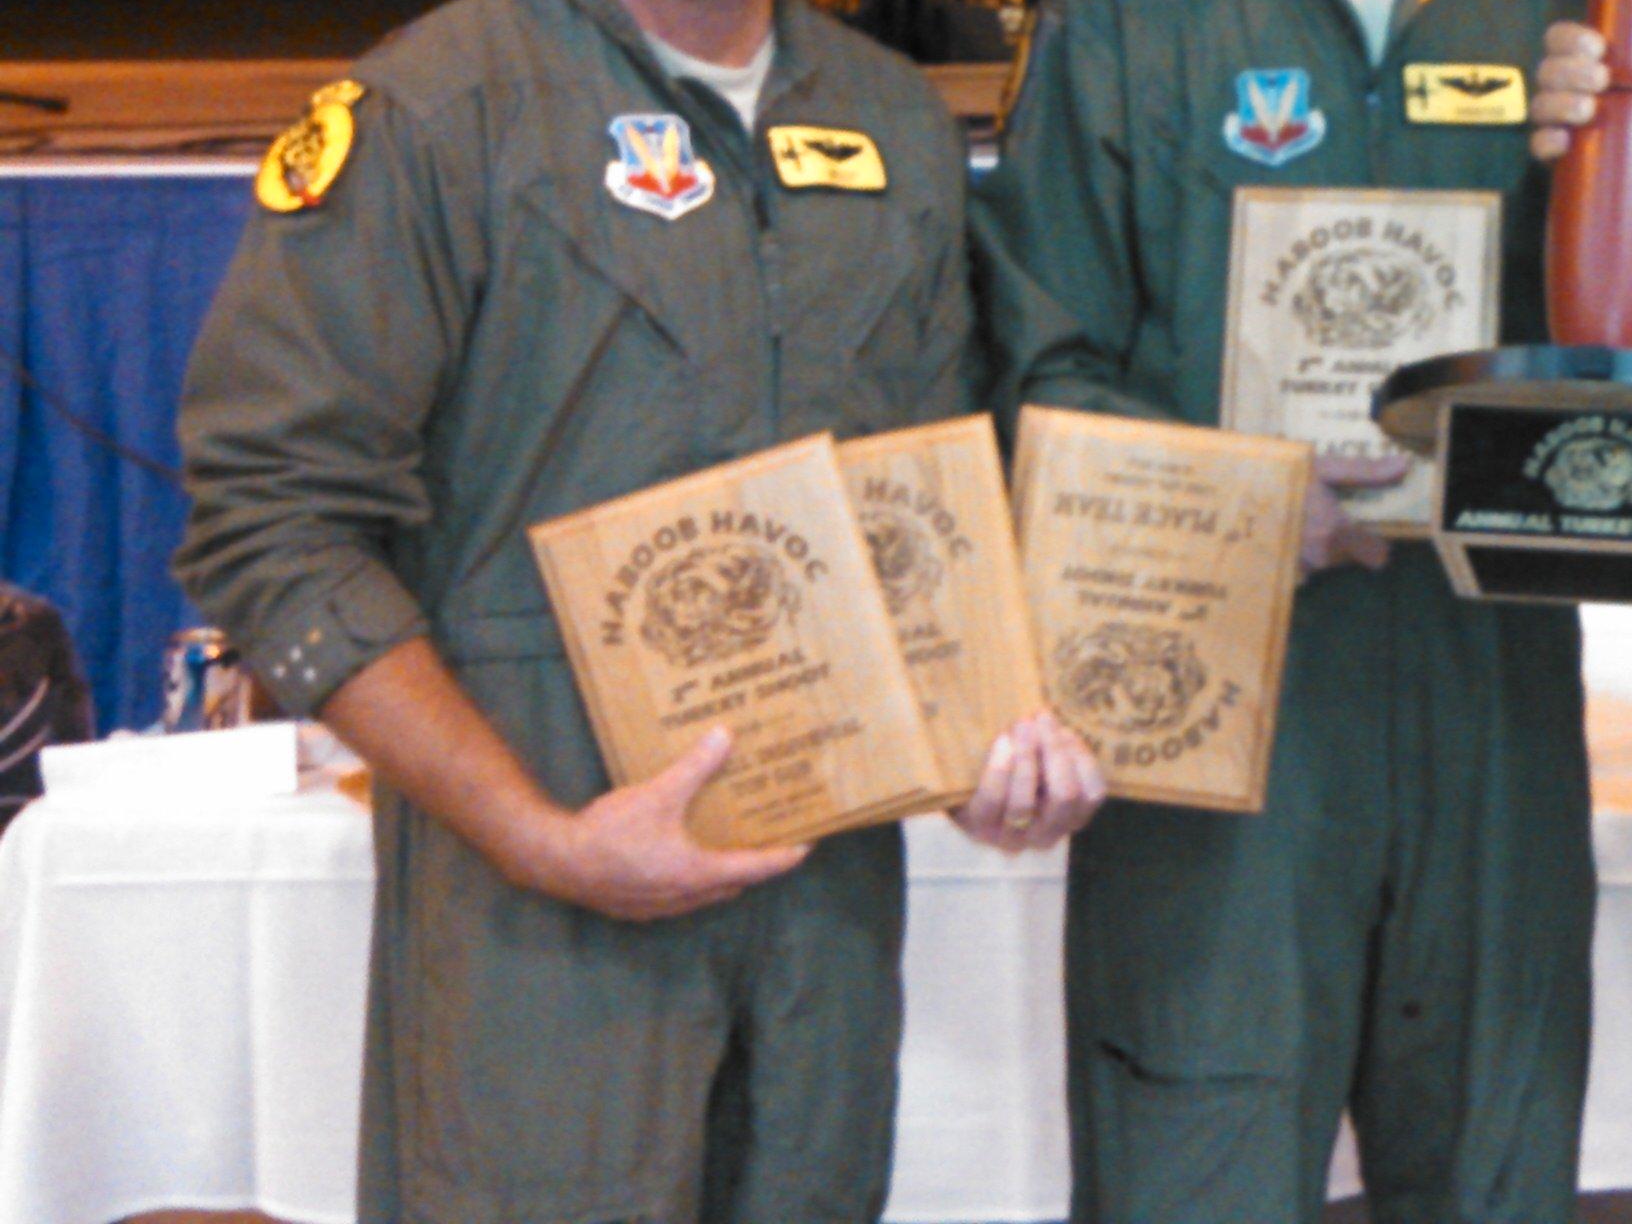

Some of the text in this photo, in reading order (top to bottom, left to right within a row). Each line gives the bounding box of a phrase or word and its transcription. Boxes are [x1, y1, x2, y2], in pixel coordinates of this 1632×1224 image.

[864, 478, 972, 558] HAVOC
[600, 511, 828, 646] HABOOB HAVOC
